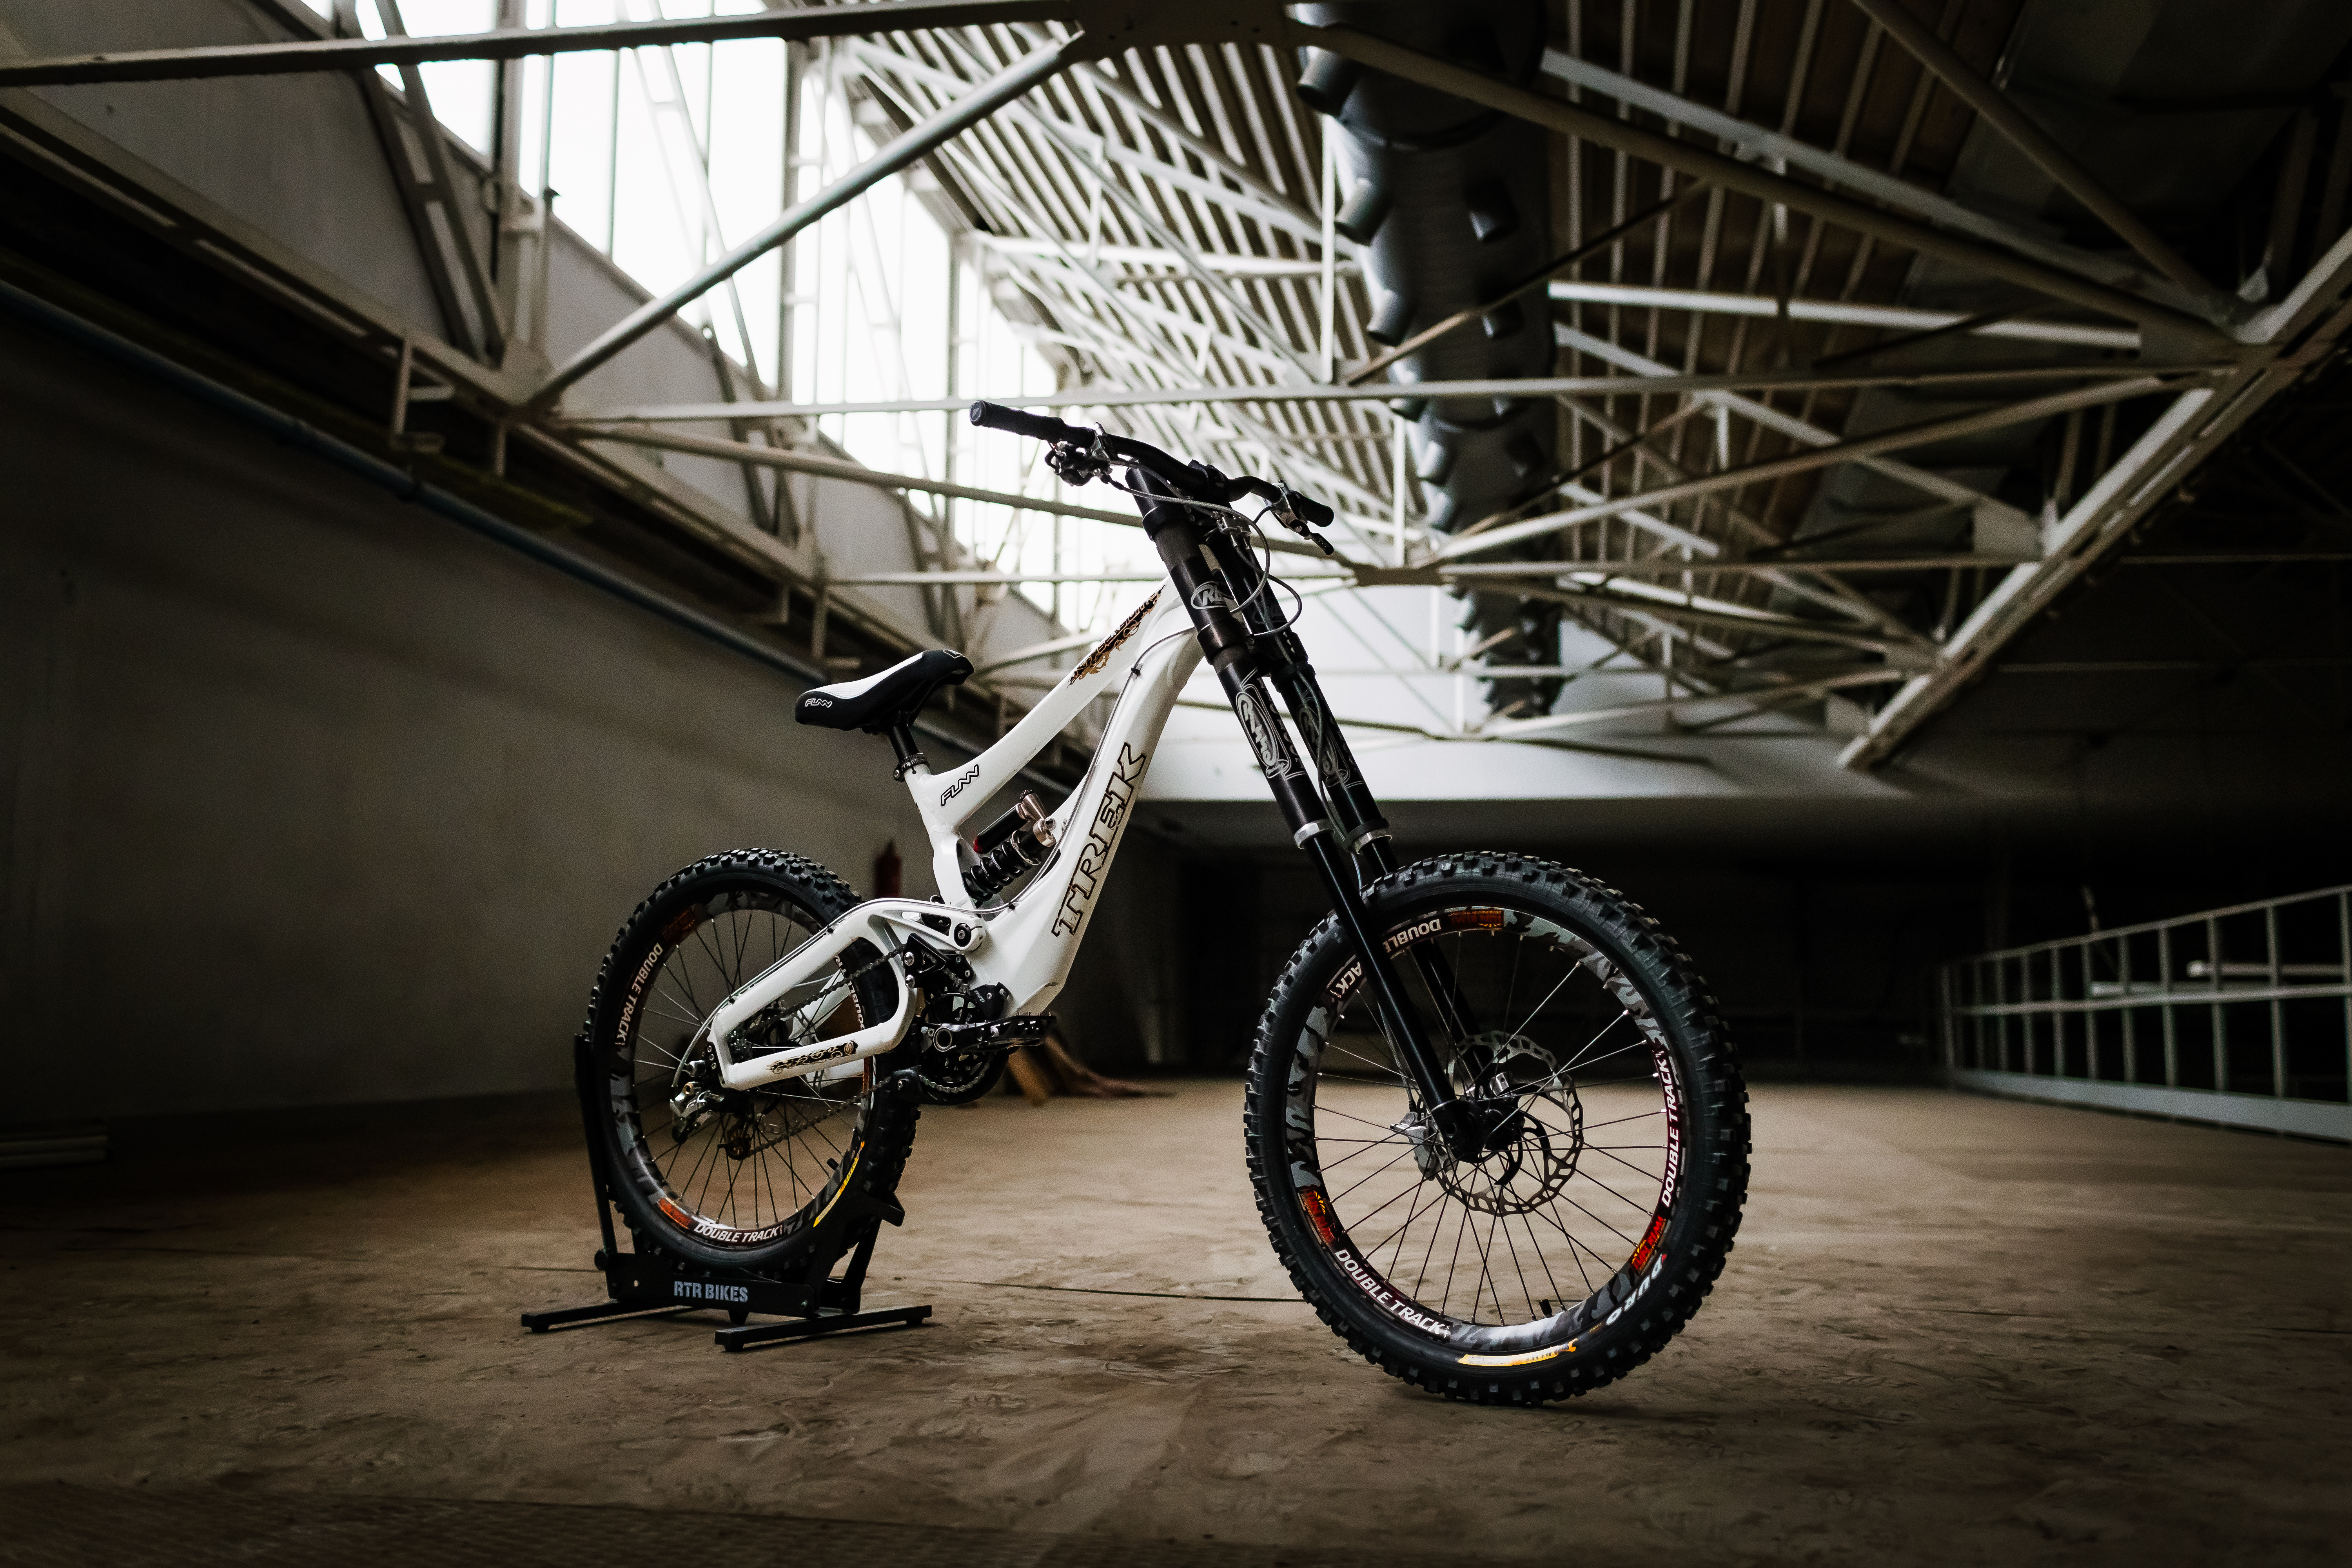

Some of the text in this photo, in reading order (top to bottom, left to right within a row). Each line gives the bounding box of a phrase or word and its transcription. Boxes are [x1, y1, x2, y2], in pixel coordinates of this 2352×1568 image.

[1051, 741, 1147, 938] TREK
[617, 942, 664, 1042] DOUBLE TRACK
[1657, 1058, 1679, 1122] TRACK
[1662, 1127, 1679, 1207] DOUBLE
[694, 1223, 778, 1243] DOUBLE TRACK
[674, 1281, 748, 1303] RTR BIKES
[1334, 1249, 1446, 1335] DOUBLE TRACK
[1606, 1253, 1662, 1325] DURO
